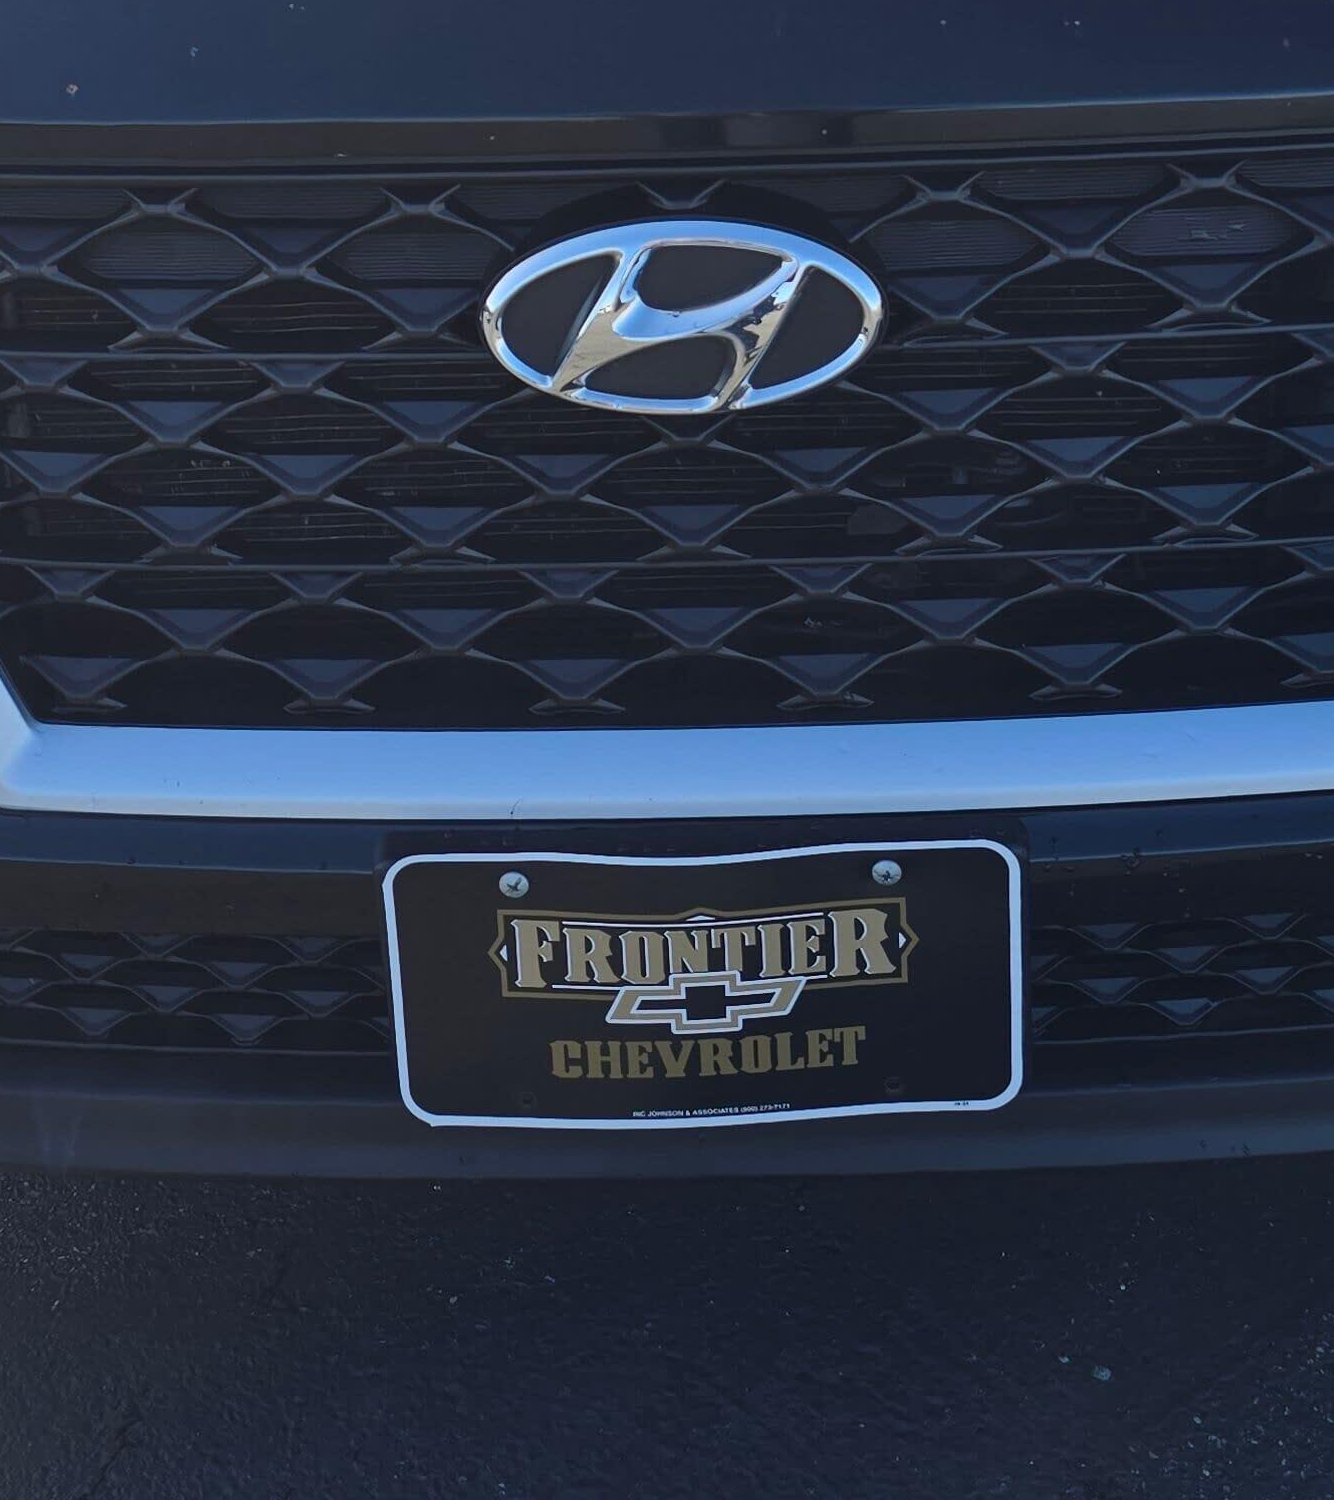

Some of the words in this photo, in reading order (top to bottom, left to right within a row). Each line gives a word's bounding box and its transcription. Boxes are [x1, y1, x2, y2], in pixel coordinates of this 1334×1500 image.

[510, 908, 897, 988] FRONTIER
[549, 1026, 867, 1079] CHEVROLET
[692, 1106, 739, 1116] ASSOCIATES
